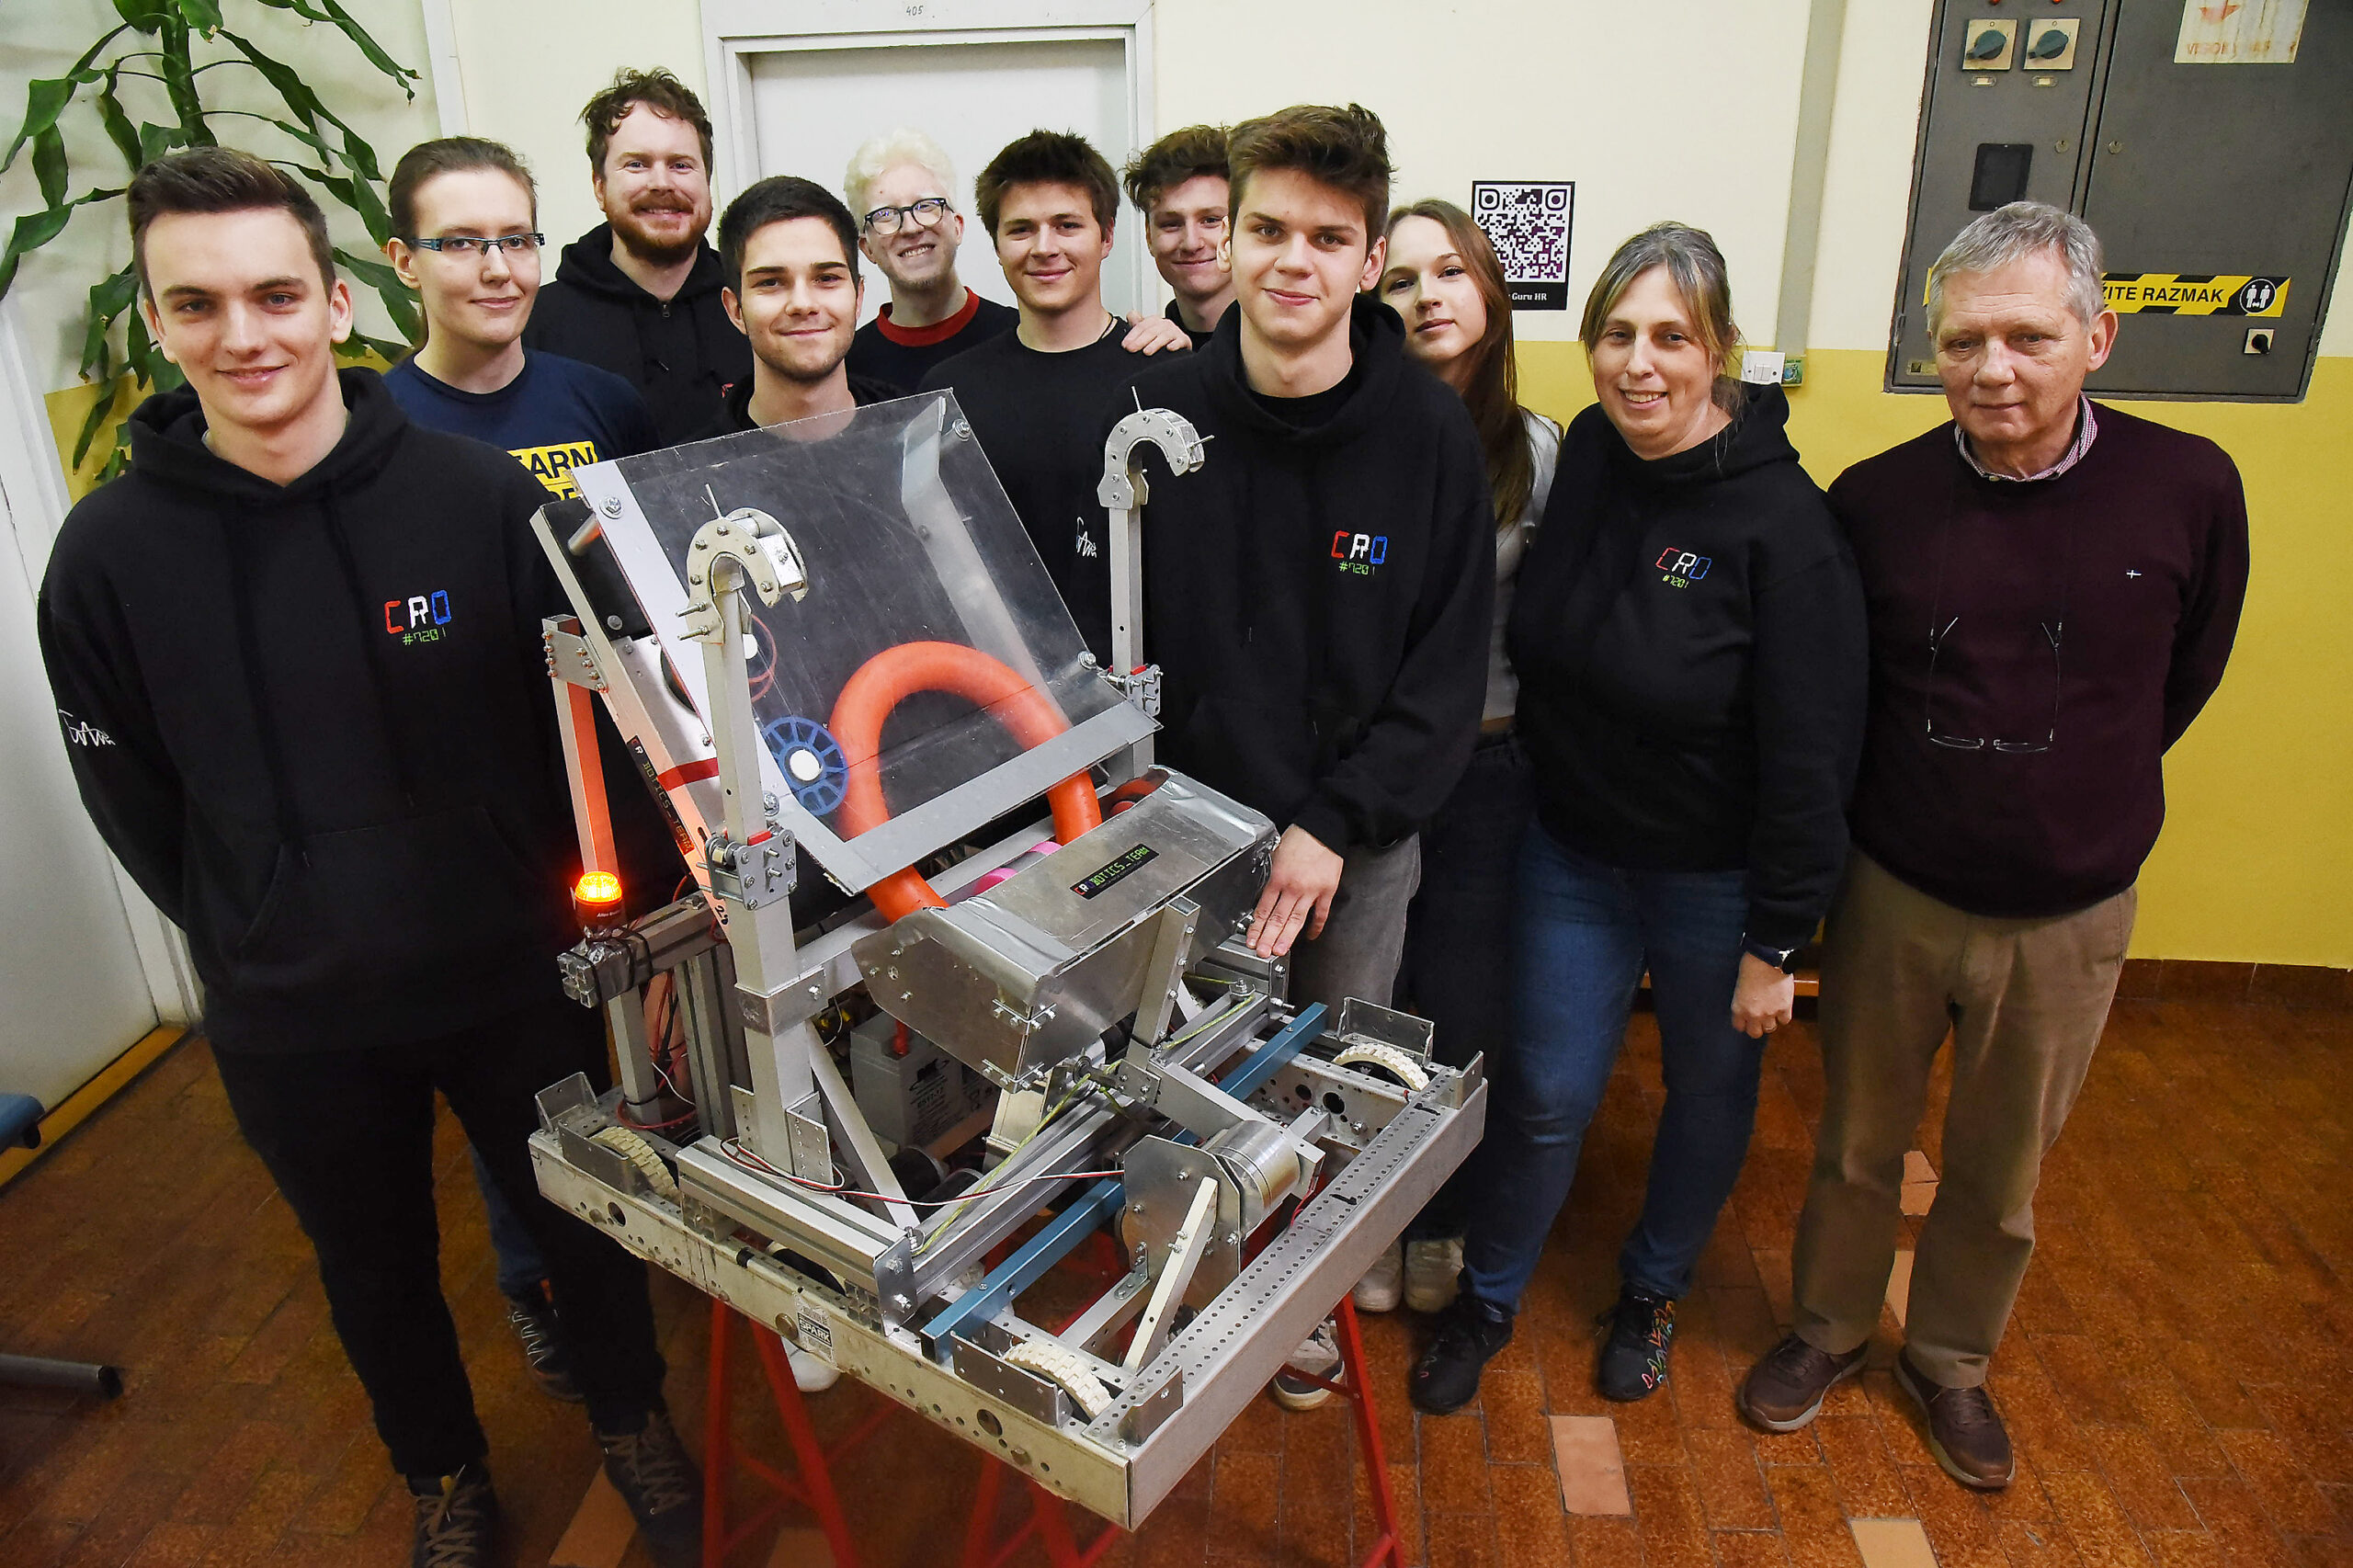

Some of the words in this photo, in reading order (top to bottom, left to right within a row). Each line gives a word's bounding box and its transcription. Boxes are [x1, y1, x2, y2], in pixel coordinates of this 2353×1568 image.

[905, 5, 924, 16] 405
[1511, 292, 1532, 301] Guru
[1534, 292, 1548, 301] HR
[2142, 287, 2224, 303] RAZMAK
[513, 446, 594, 479] ARN
[1331, 530, 1388, 564] CRO
[1655, 547, 1712, 580] CRO
[384, 589, 452, 634] CRO
[799, 1319, 831, 1343] SPARK
